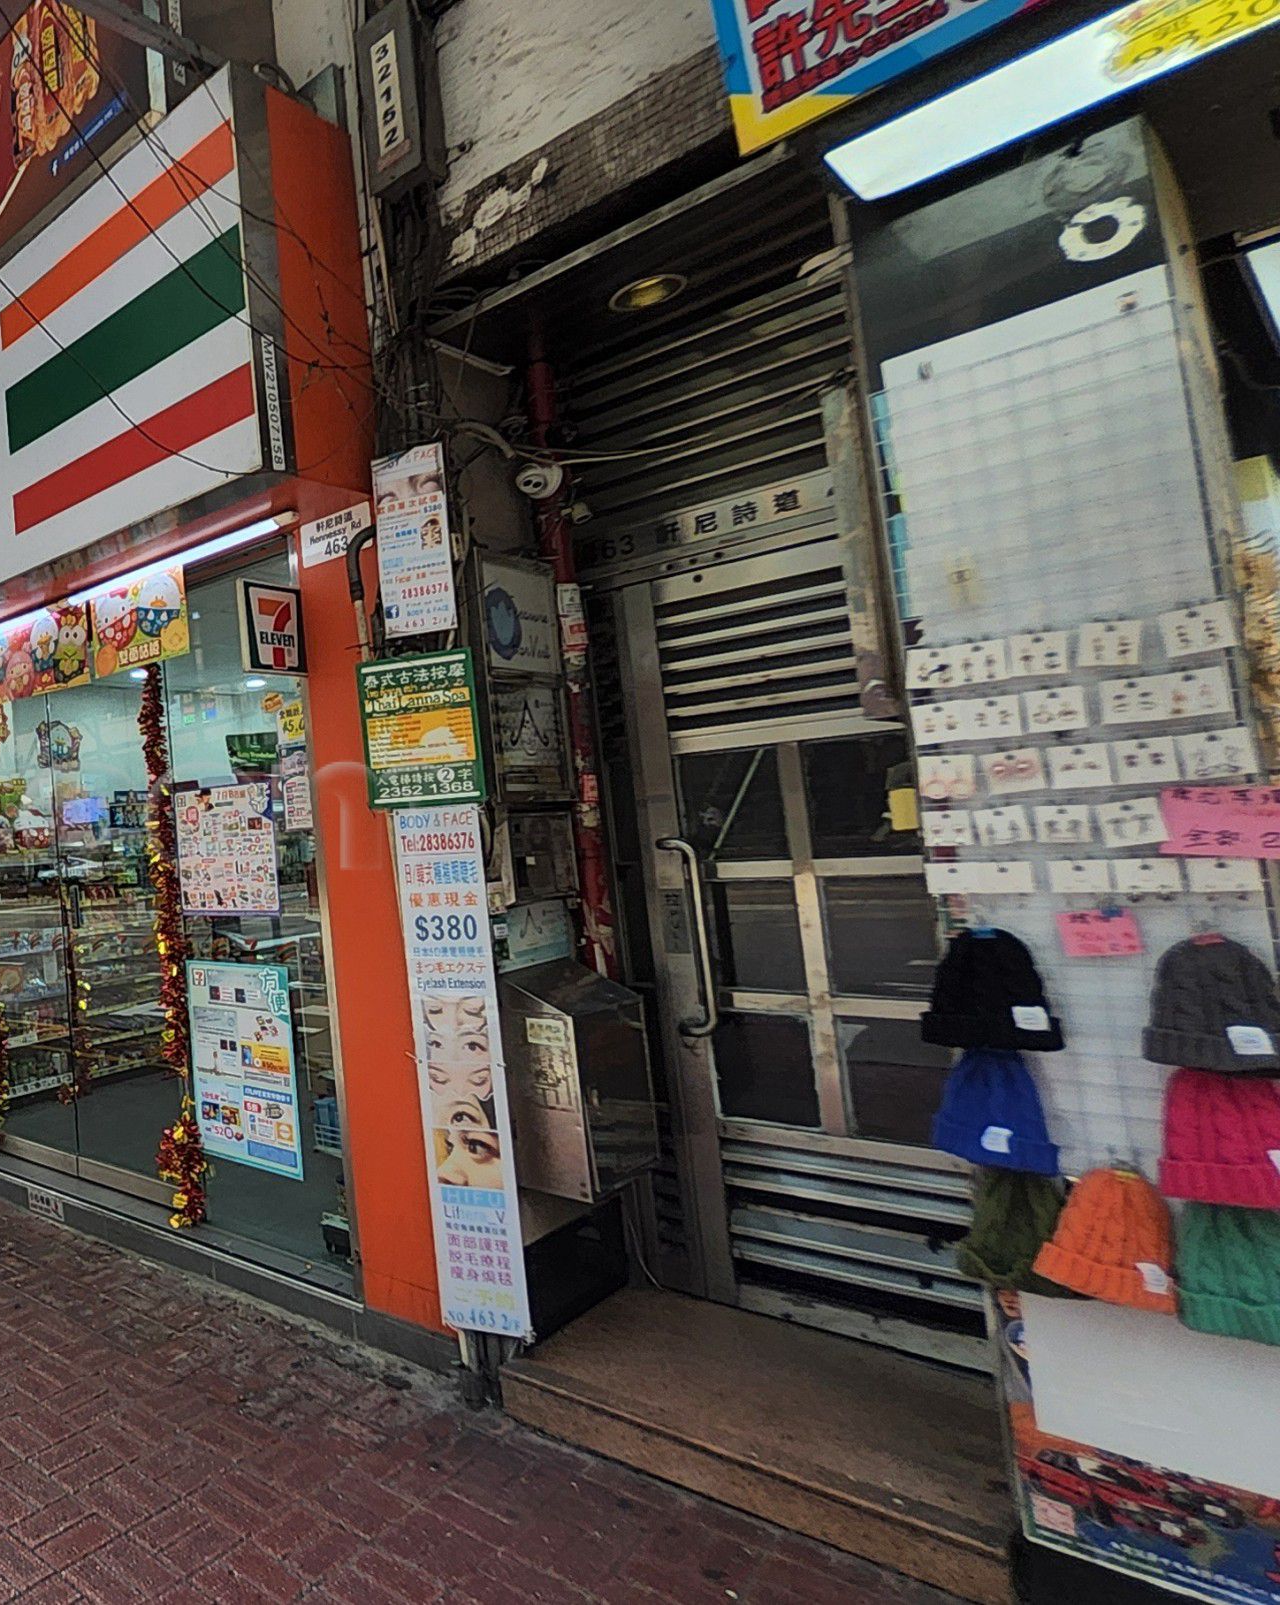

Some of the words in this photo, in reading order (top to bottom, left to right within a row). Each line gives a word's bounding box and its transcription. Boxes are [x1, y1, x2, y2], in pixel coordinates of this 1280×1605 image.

[310, 526, 348, 545] Hennessy
[350, 518, 362, 531] Rd
[324, 535, 349, 557] 463
[401, 582, 449, 599] 28386376
[257, 597, 292, 669] 7
[364, 663, 467, 688] 泰式古法按摩
[441, 768, 451, 780] 2
[457, 768, 473, 780] 字
[379, 785, 423, 798] 2352
[429, 781, 474, 794] 1368
[400, 814, 431, 829] BODY
[433, 813, 441, 826] &
[443, 811, 473, 826] FACE
[401, 831, 475, 853] Tel:28386376
[408, 892, 479, 909] 優惠現金
[414, 914, 478, 942] $380
[415, 961, 487, 974] まつ毛エクステ
[259, 968, 289, 1016] 方便
[417, 977, 447, 992] Eyelash
[448, 978, 487, 989] Extension
